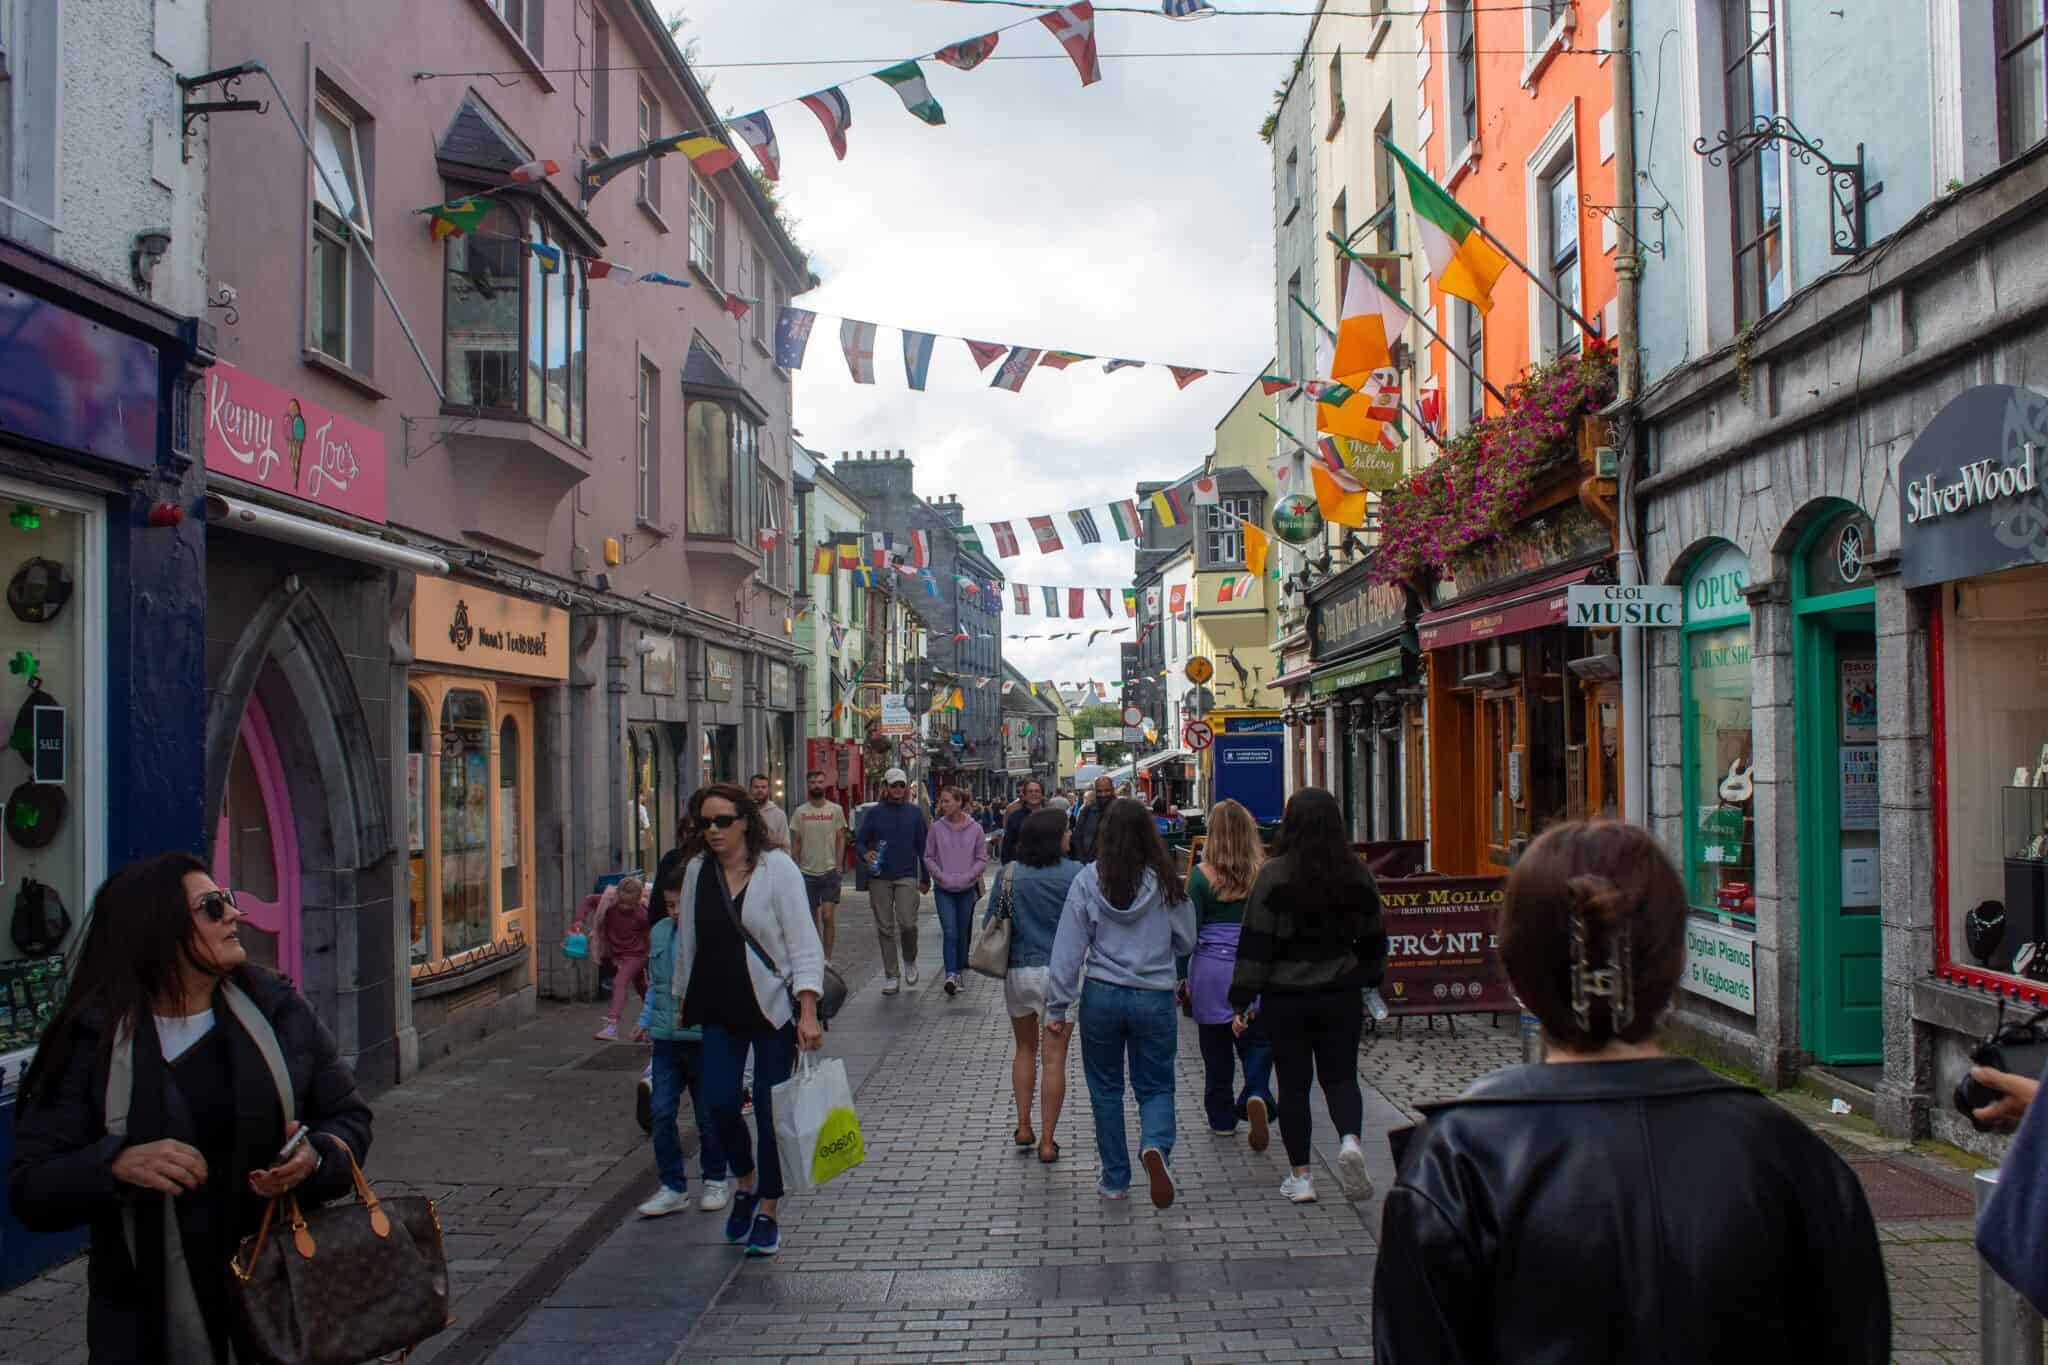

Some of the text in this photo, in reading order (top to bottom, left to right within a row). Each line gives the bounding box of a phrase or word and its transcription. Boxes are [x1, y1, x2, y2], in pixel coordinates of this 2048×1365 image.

[210, 373, 360, 497] Kenny Joe's
[1351, 454, 1393, 472] Gallery
[1907, 441, 2039, 523] SilverWood
[1279, 519, 1318, 530] Heine
[1604, 586, 1644, 600] CEOL
[1695, 570, 1743, 610] OPUS
[1575, 602, 1673, 624] MUSIC
[1701, 643, 1751, 669] MUSIC SHO
[39, 739, 63, 750] SALE
[1380, 890, 1505, 907] NNY MOLLO
[1425, 905, 1461, 913] WHISKEY
[1463, 904, 1480, 912] BAR
[1386, 929, 1482, 956] FRONT
[1687, 932, 1750, 968] Digital Pianos
[1692, 962, 1749, 1000] & Keyboards
[819, 1130, 858, 1159] eason
